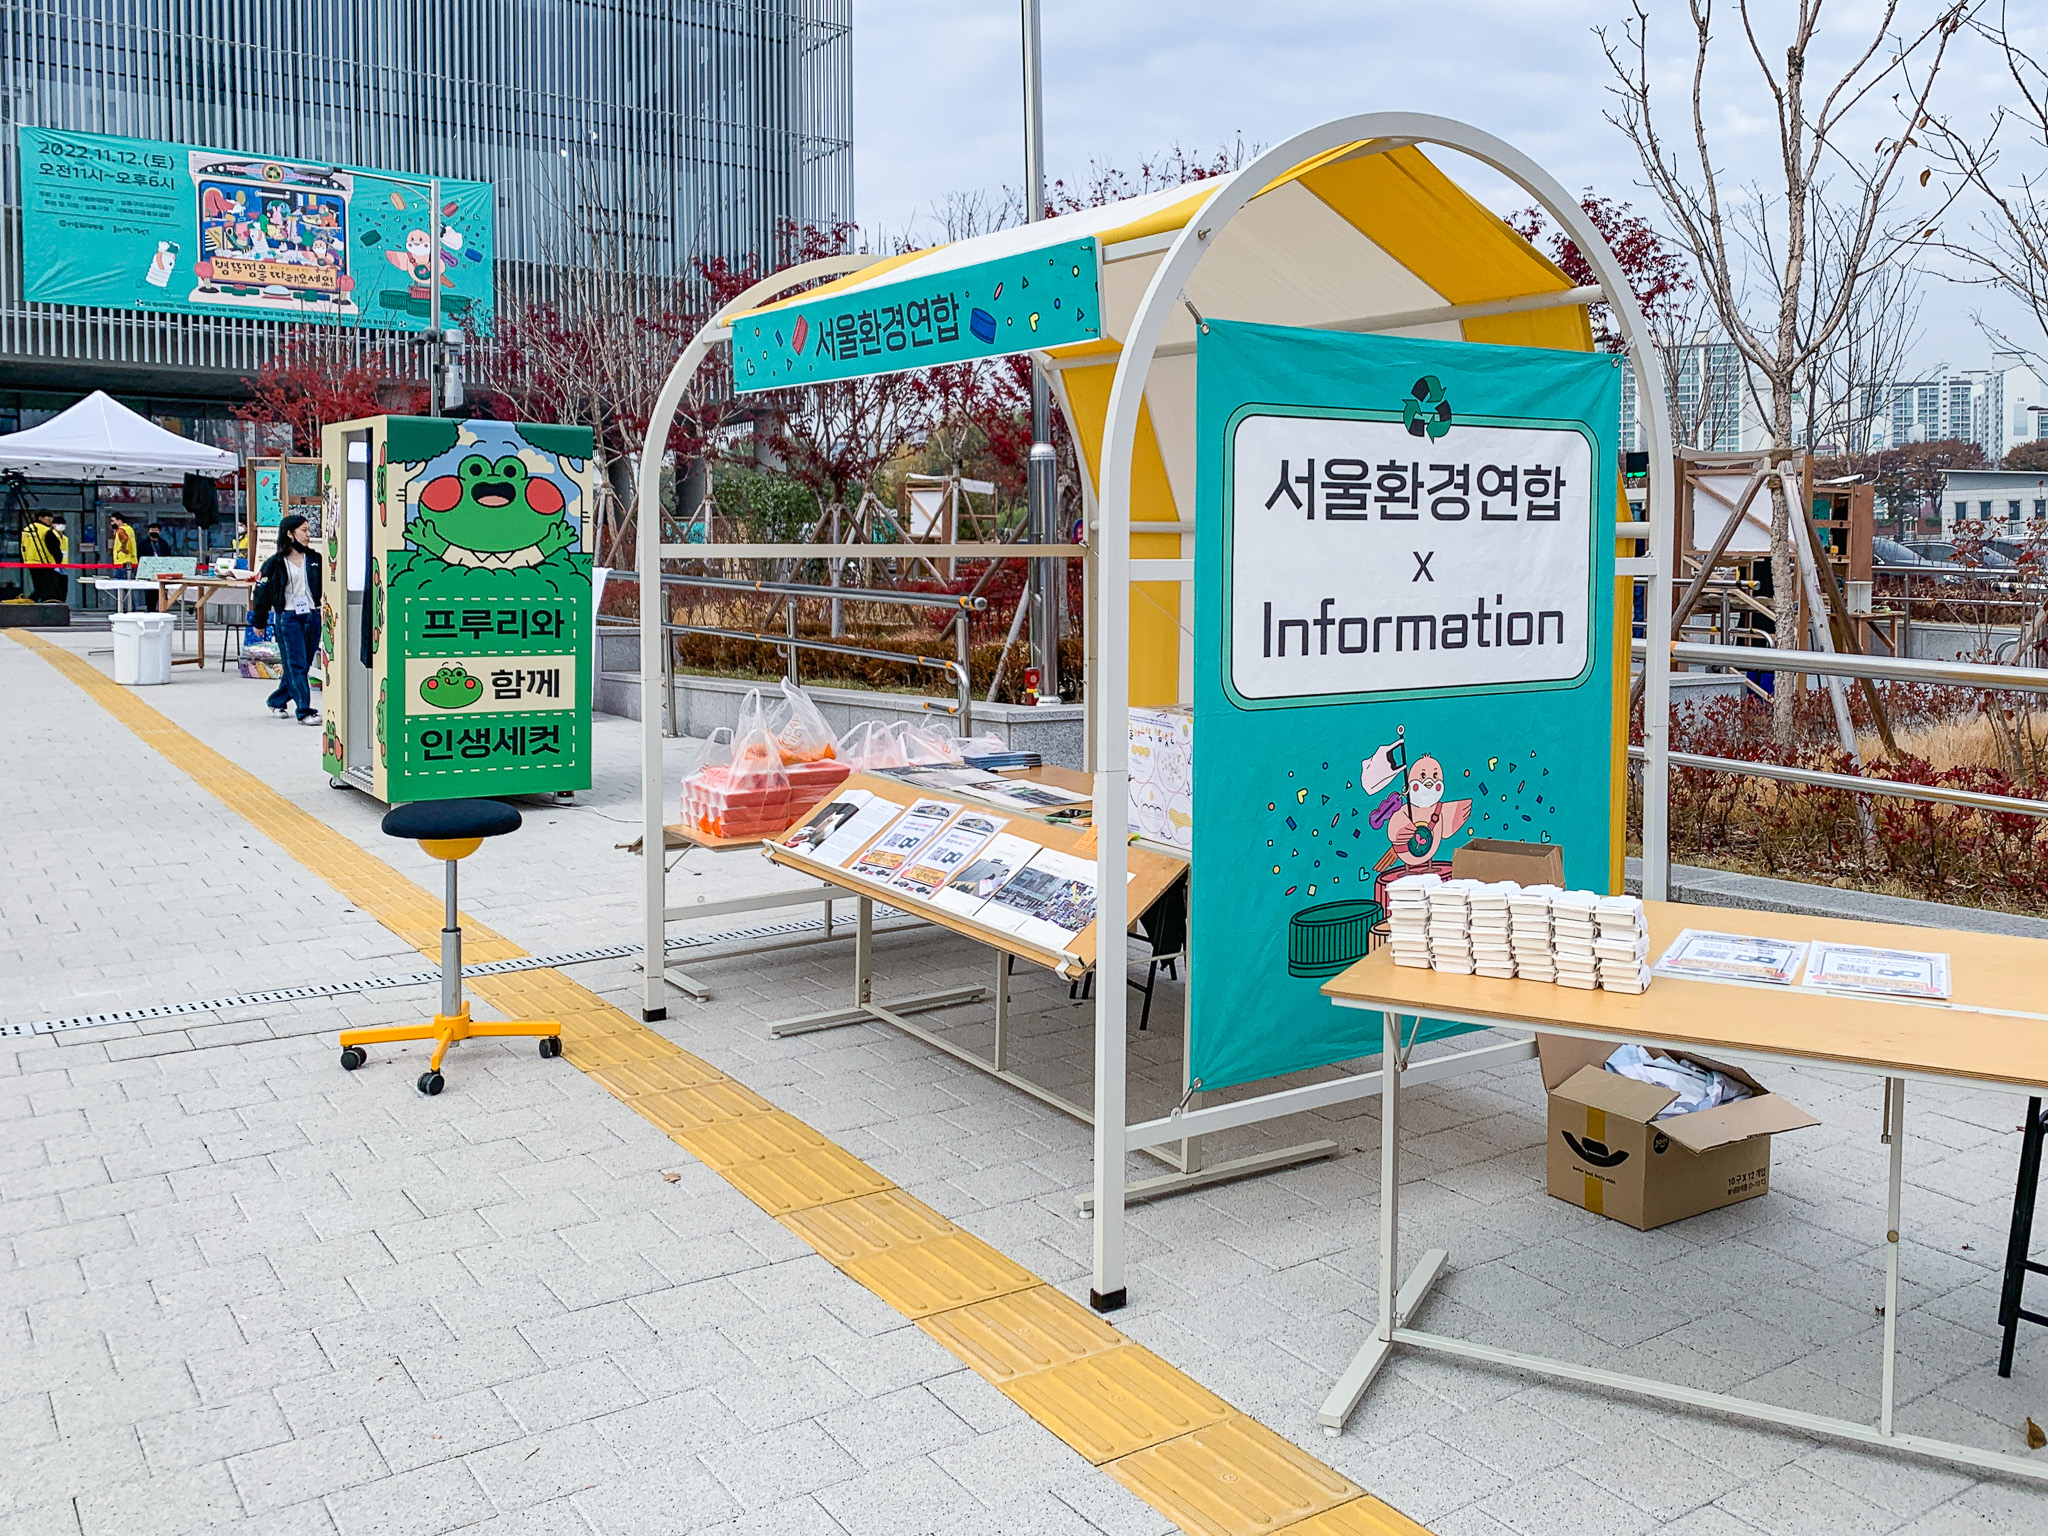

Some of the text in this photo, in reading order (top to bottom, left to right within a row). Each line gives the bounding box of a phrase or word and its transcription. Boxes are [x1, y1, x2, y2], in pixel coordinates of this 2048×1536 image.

[39, 162, 174, 190] 오전11시~오후6시
[815, 292, 960, 361] 서울환경연합
[1264, 458, 1567, 522] 서울환경연합
[422, 608, 565, 639] 프루리와
[1263, 593, 1564, 658] Information
[490, 668, 560, 700] 함께
[420, 725, 561, 761] 인생세컷
